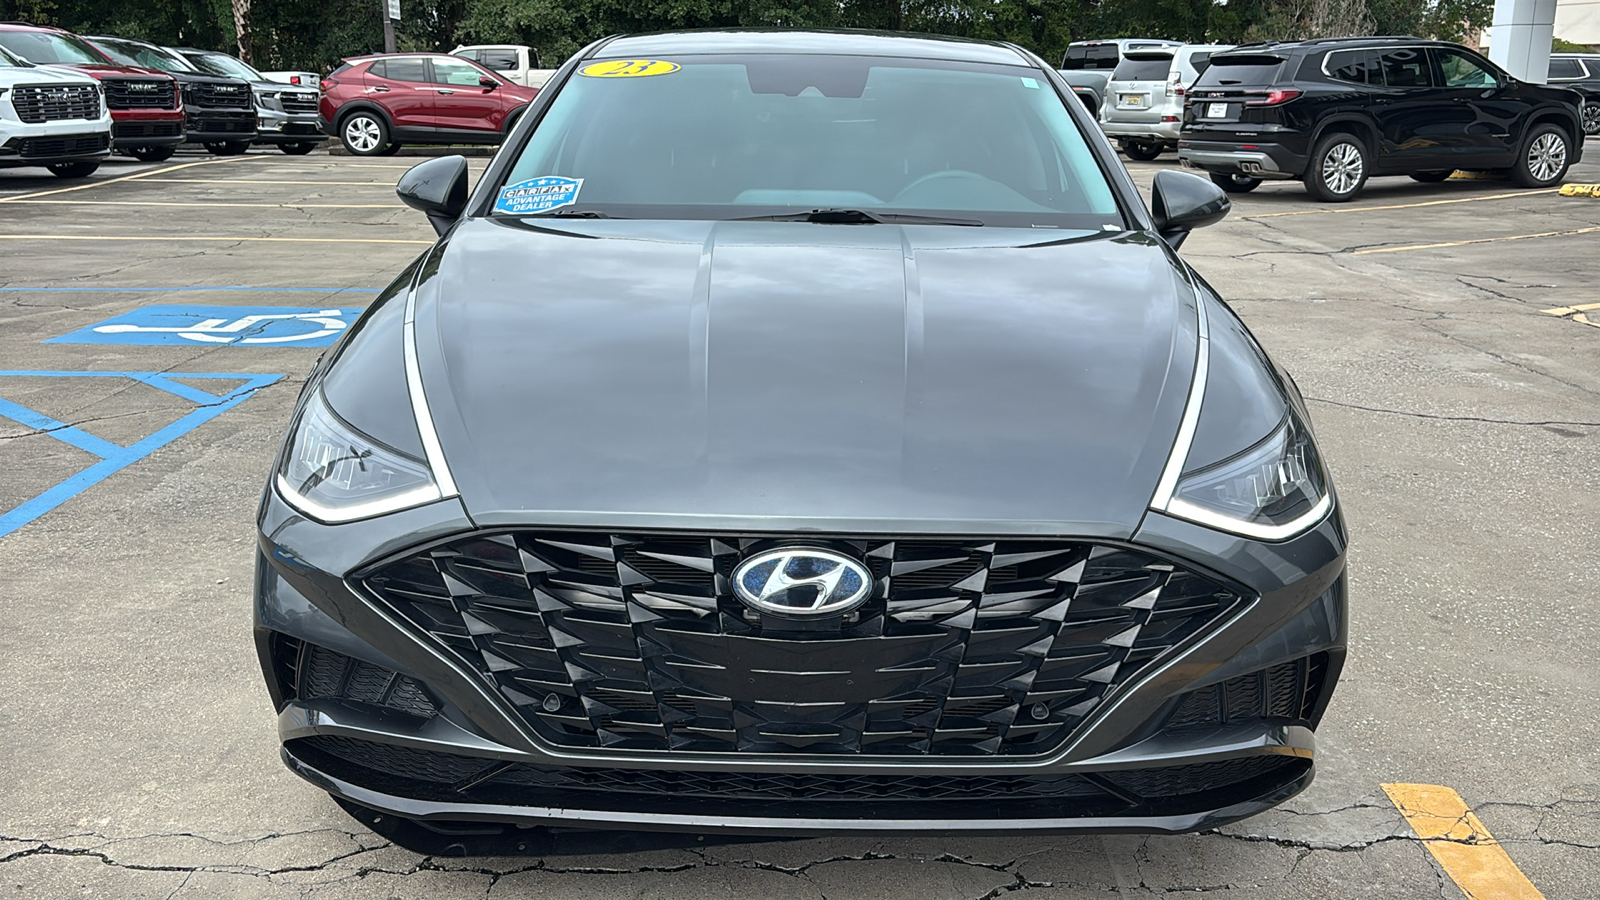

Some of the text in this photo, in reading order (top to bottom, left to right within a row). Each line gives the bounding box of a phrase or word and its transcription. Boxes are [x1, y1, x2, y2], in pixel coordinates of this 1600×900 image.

[600, 61, 657, 75] 23
[504, 184, 575, 198] CARFAX
[505, 193, 566, 206] ADVANTAGE
[513, 201, 553, 211] DEALER
